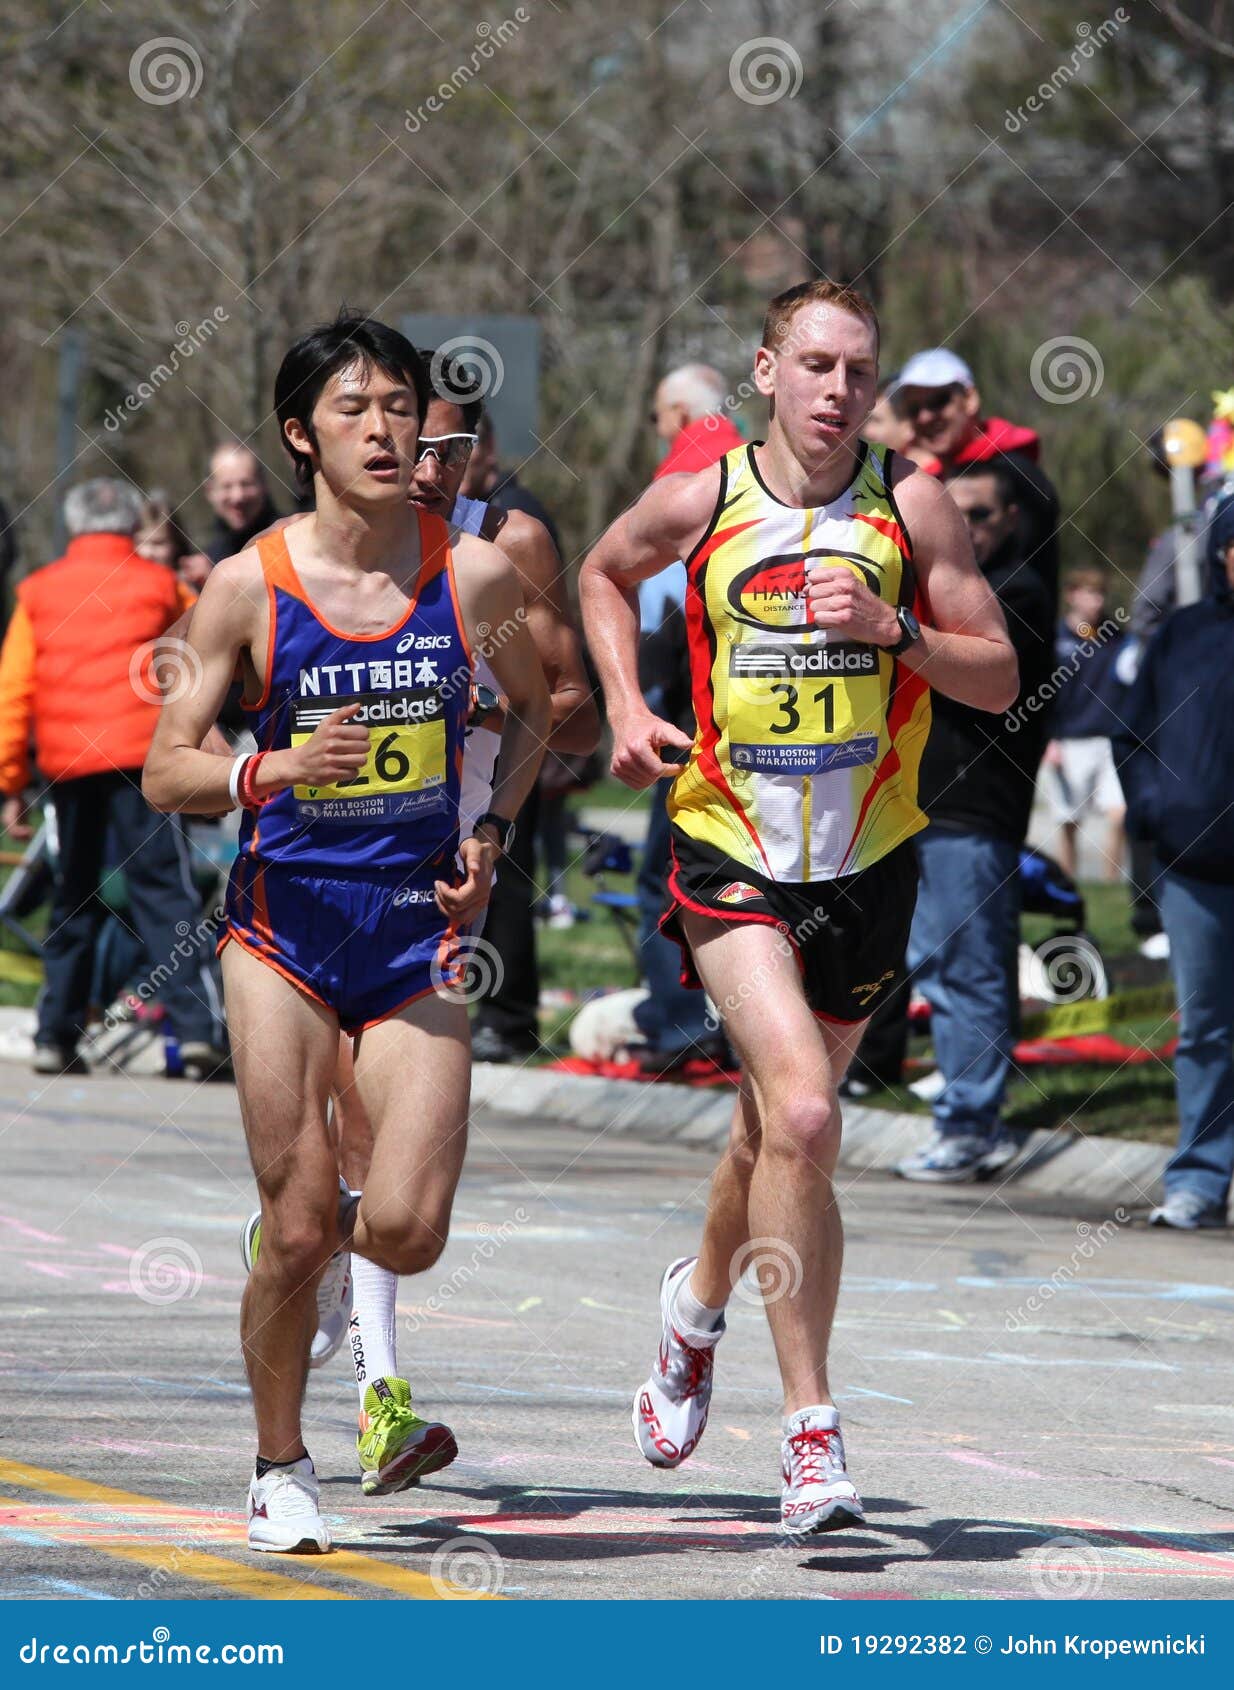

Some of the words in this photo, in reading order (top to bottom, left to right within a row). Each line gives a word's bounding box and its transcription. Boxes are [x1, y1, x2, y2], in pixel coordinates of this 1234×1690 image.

[790, 650, 874, 670] adidas
[300, 657, 438, 697] NTT西日本
[352, 696, 438, 721] adidas
[769, 683, 835, 735] 31
[756, 749, 776, 757] 2011
[779, 749, 816, 757] BOSTON
[756, 757, 817, 766] MARATHON
[323, 802, 344, 810] 2011
[347, 798, 384, 809] BOSTON
[323, 806, 385, 818] MARATHON
[351, 1335, 367, 1382] SOCKS
[640, 1392, 709, 1460] BROO
